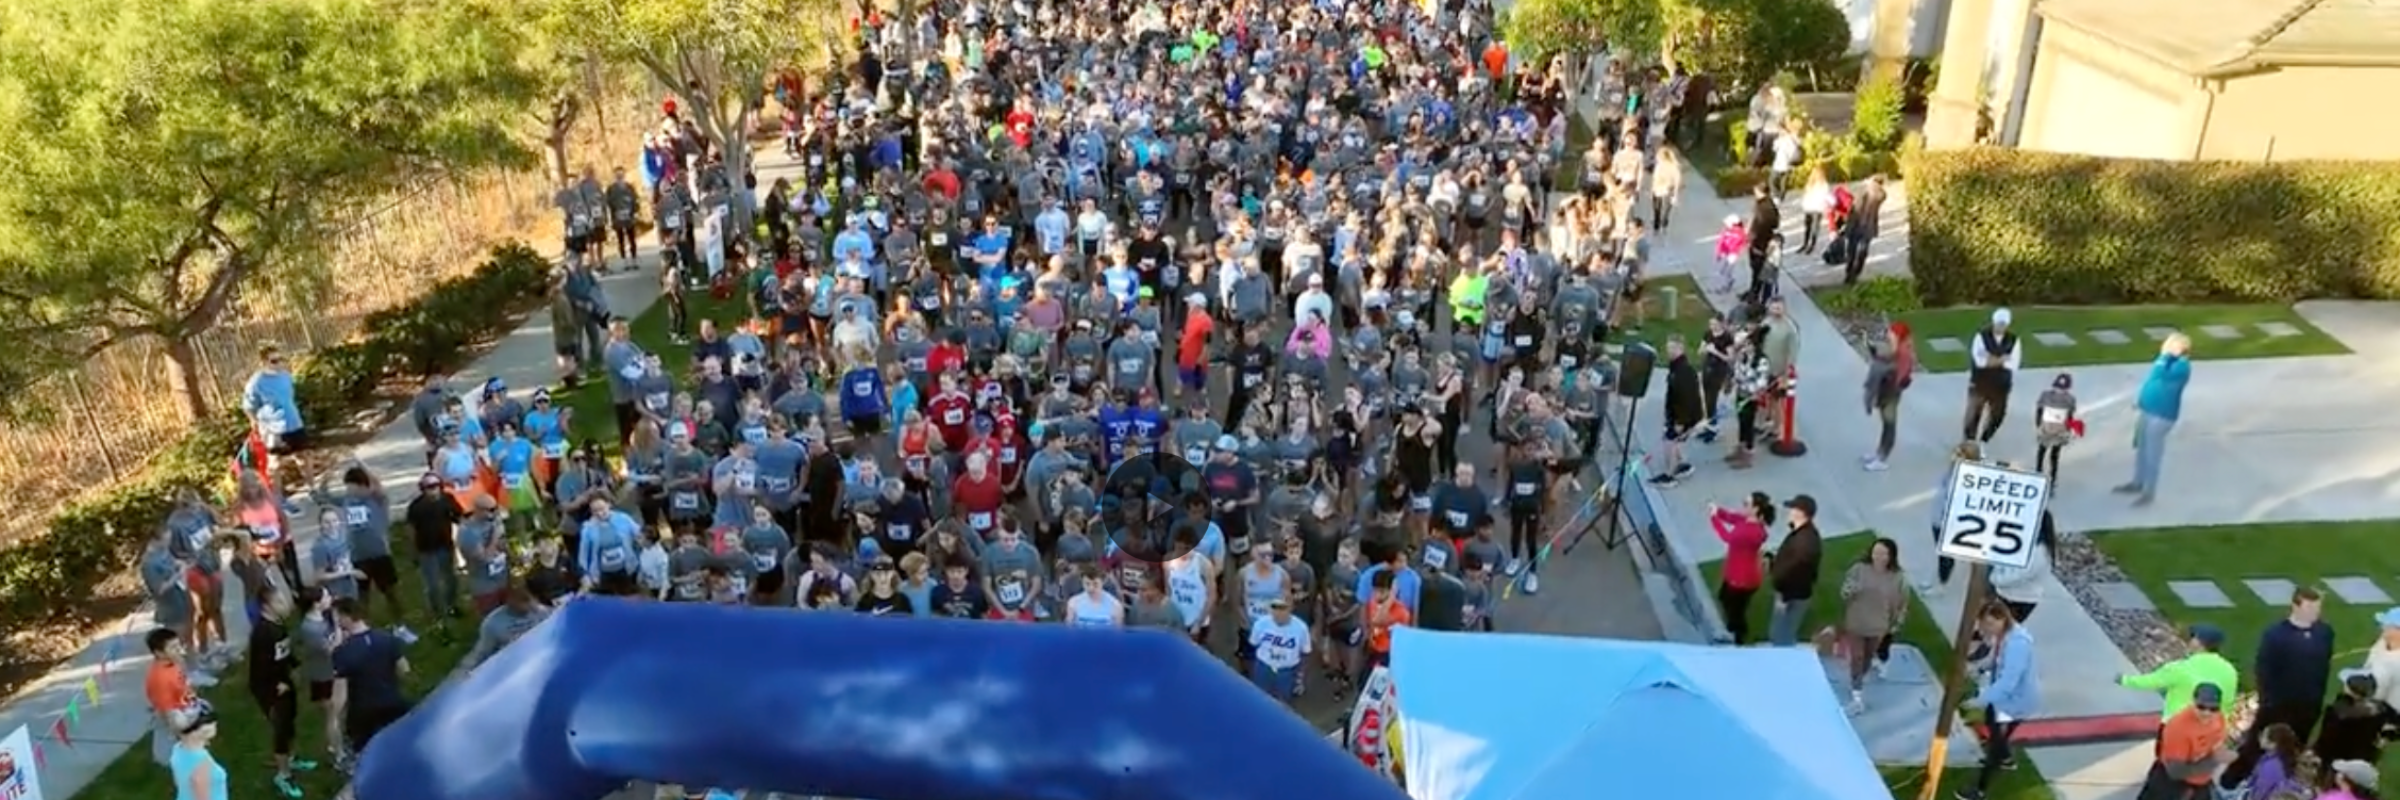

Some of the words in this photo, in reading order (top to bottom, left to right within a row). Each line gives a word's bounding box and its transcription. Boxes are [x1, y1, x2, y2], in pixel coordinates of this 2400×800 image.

[1962, 473, 2038, 500] SPEED
[1965, 494, 2026, 518] LIMIT
[1951, 514, 2024, 555] 25
[1261, 632, 1296, 650] FILA
